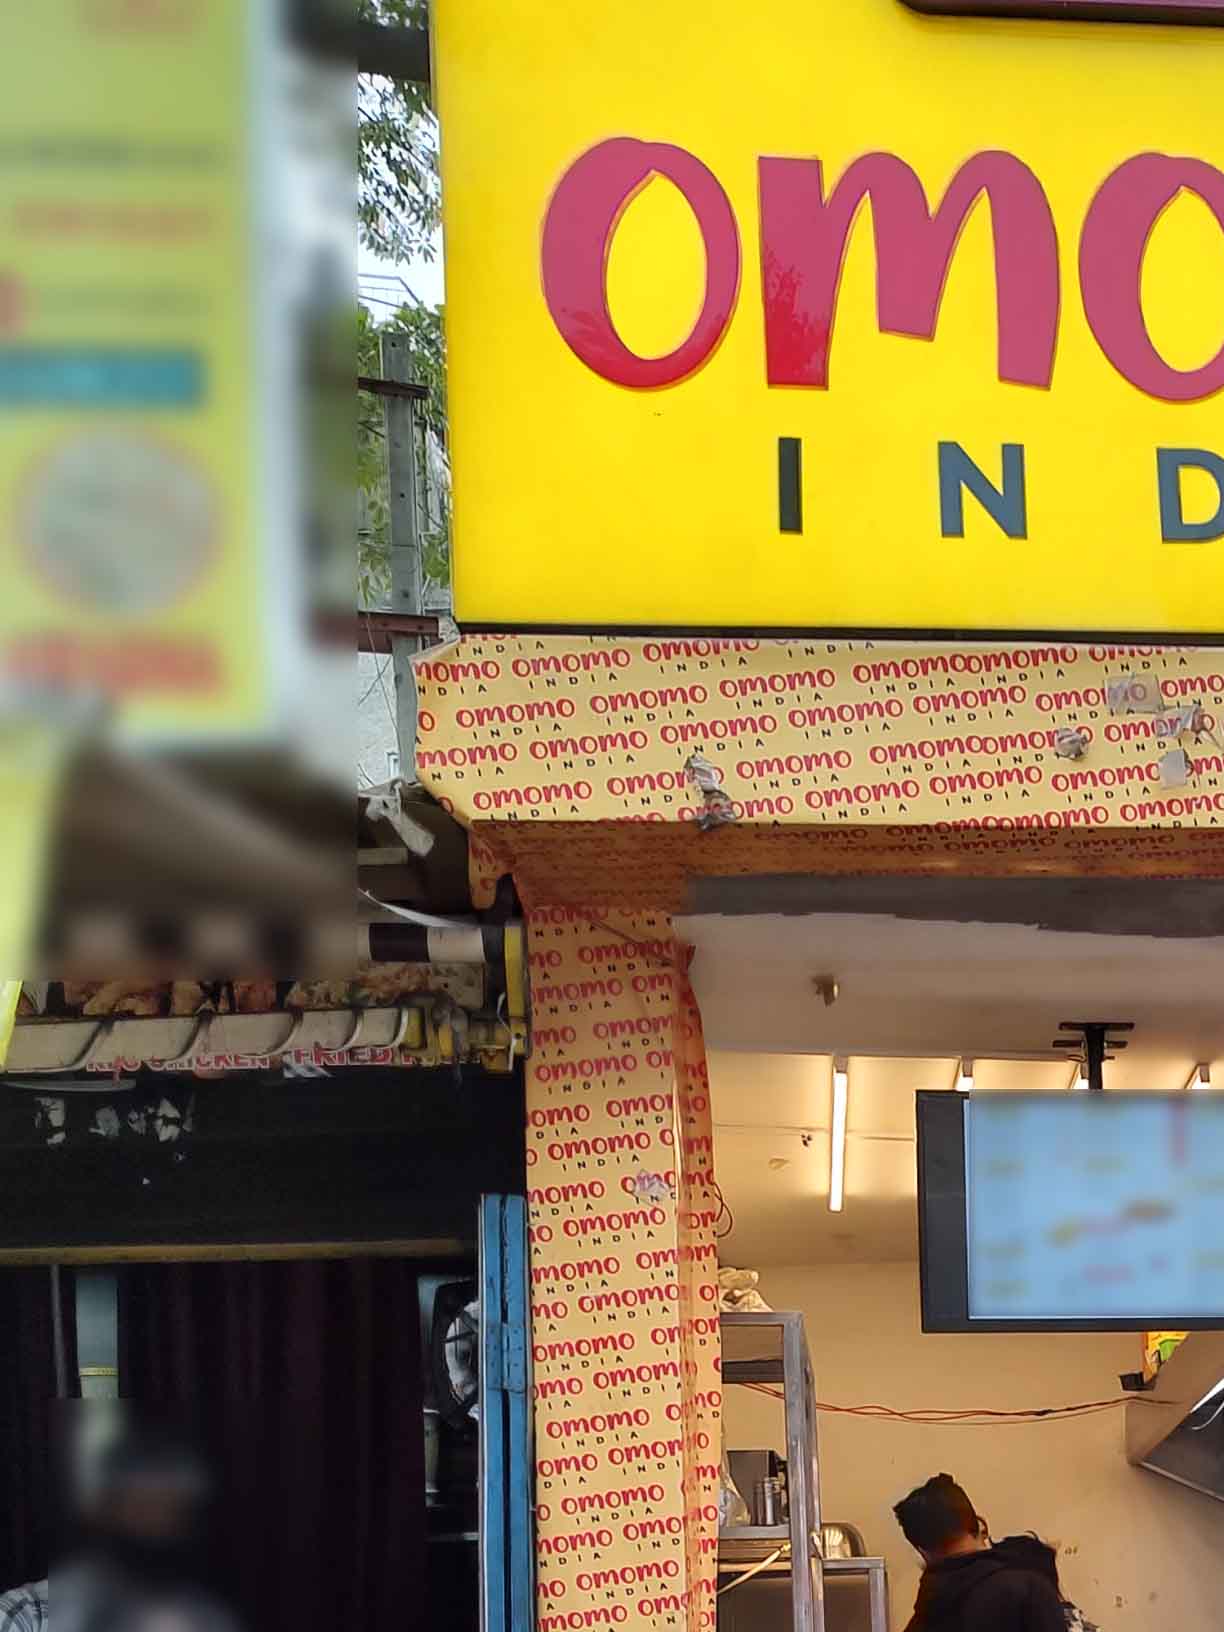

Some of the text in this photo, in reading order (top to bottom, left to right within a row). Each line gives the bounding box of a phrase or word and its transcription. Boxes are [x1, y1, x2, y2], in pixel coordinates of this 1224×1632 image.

[456, 637, 543, 656] INDIA
[788, 643, 873, 657] INDIA
[660, 657, 747, 673] INDIA
[1105, 657, 1187, 672] INDIA
[529, 673, 617, 688] INDIA
[981, 669, 1064, 685] INDIA
[870, 678, 954, 695] INDIA
[736, 693, 822, 709] INDIA
[607, 709, 694, 725] INDIA
[930, 709, 1013, 725] INDIA
[473, 723, 561, 739] INDIA
[805, 723, 890, 739] INDIA
[677, 739, 764, 754] INDIA
[547, 755, 634, 771] INDIA
[887, 759, 971, 776] INDIA
[753, 774, 838, 790] INDIA
[946, 790, 1029, 806] INDIA
[1068, 786, 1150, 803] INDIA
[490, 806, 579, 822] INDIA
[822, 804, 906, 820] INDIA
[563, 1155, 639, 1171] INDIA
[578, 1231, 654, 1245] INDIA
[546, 1356, 623, 1373] INDIA
[561, 1432, 638, 1448] INDIA
[576, 1507, 653, 1525] INDIA
[591, 1585, 668, 1600] INDIA
